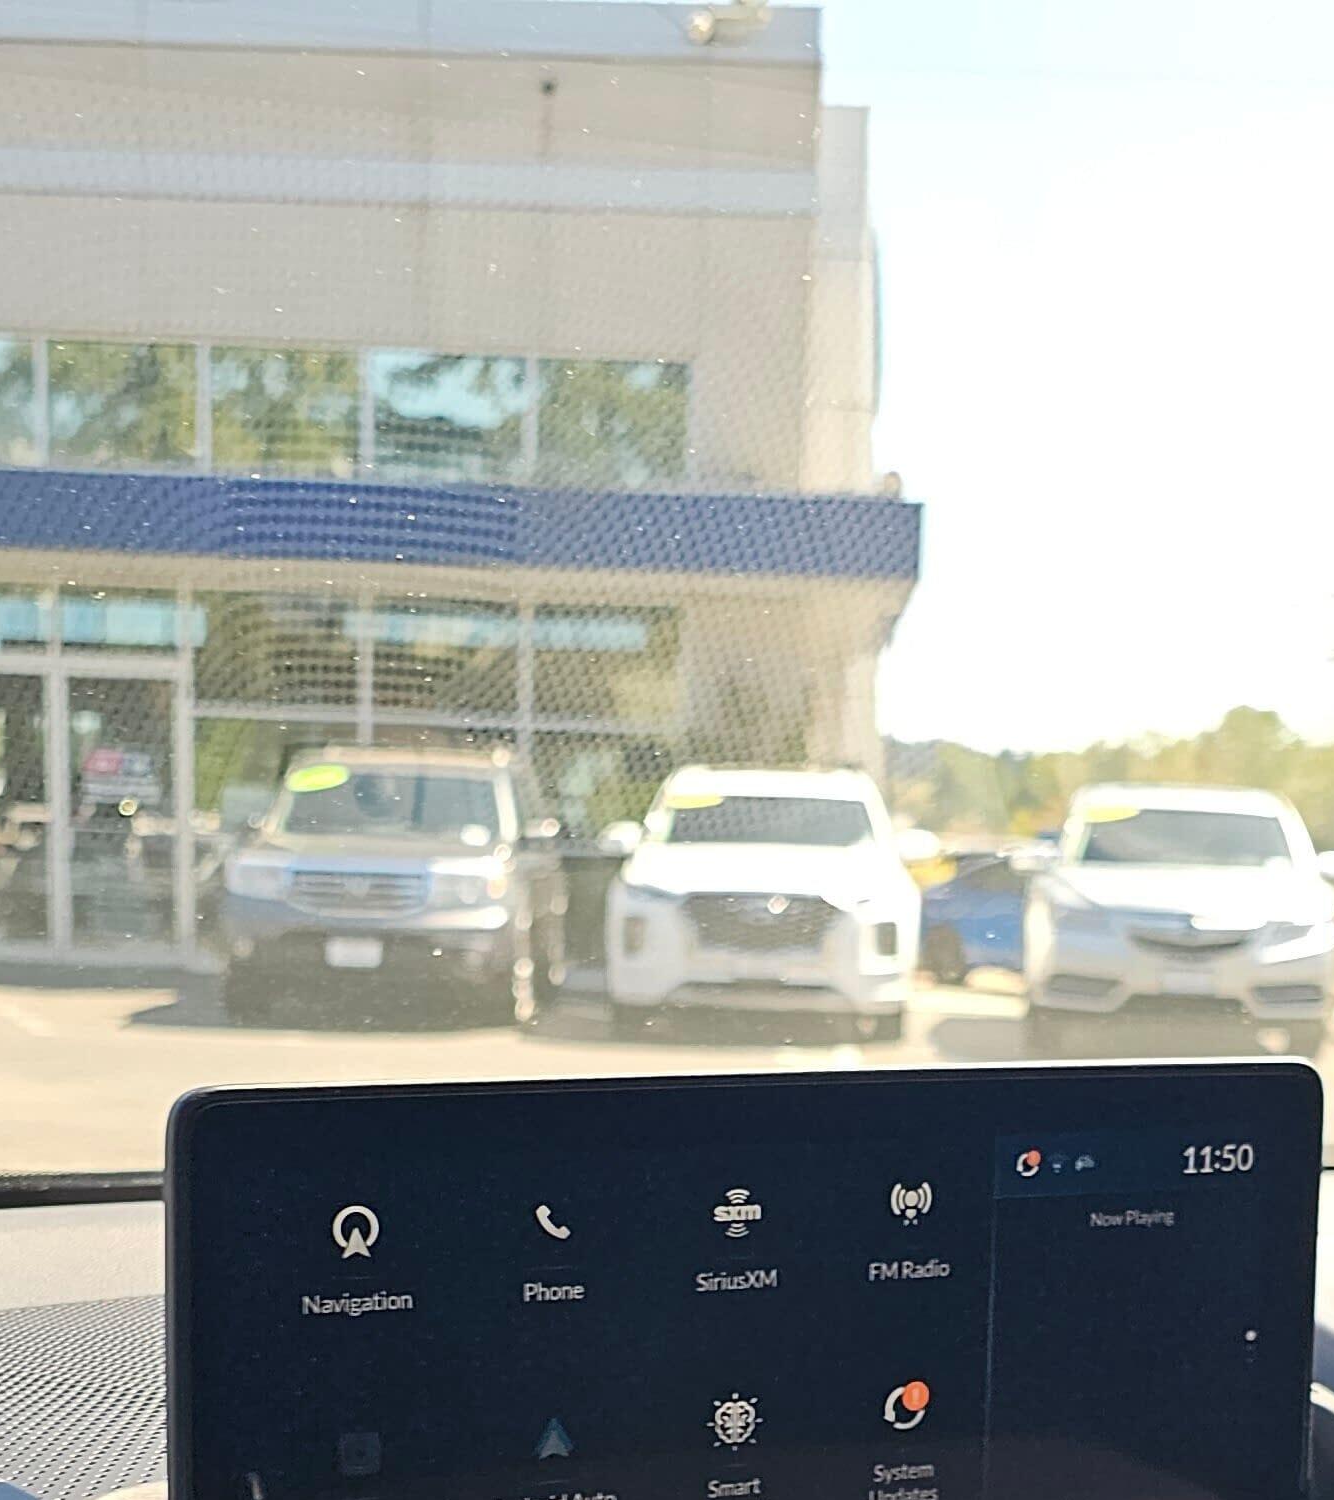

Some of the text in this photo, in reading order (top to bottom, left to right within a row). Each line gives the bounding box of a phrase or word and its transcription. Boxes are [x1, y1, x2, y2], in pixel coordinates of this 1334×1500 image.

[1181, 1143, 1255, 1174] 11:50
[1089, 1209, 1175, 1228] Now Playing
[695, 1269, 778, 1292] SiriusXM
[868, 1259, 951, 1281] FM Radio
[301, 1290, 414, 1317] Navigation
[522, 1282, 586, 1303] Phone
[872, 1464, 935, 1485] System
[707, 1477, 762, 1499] Smart
